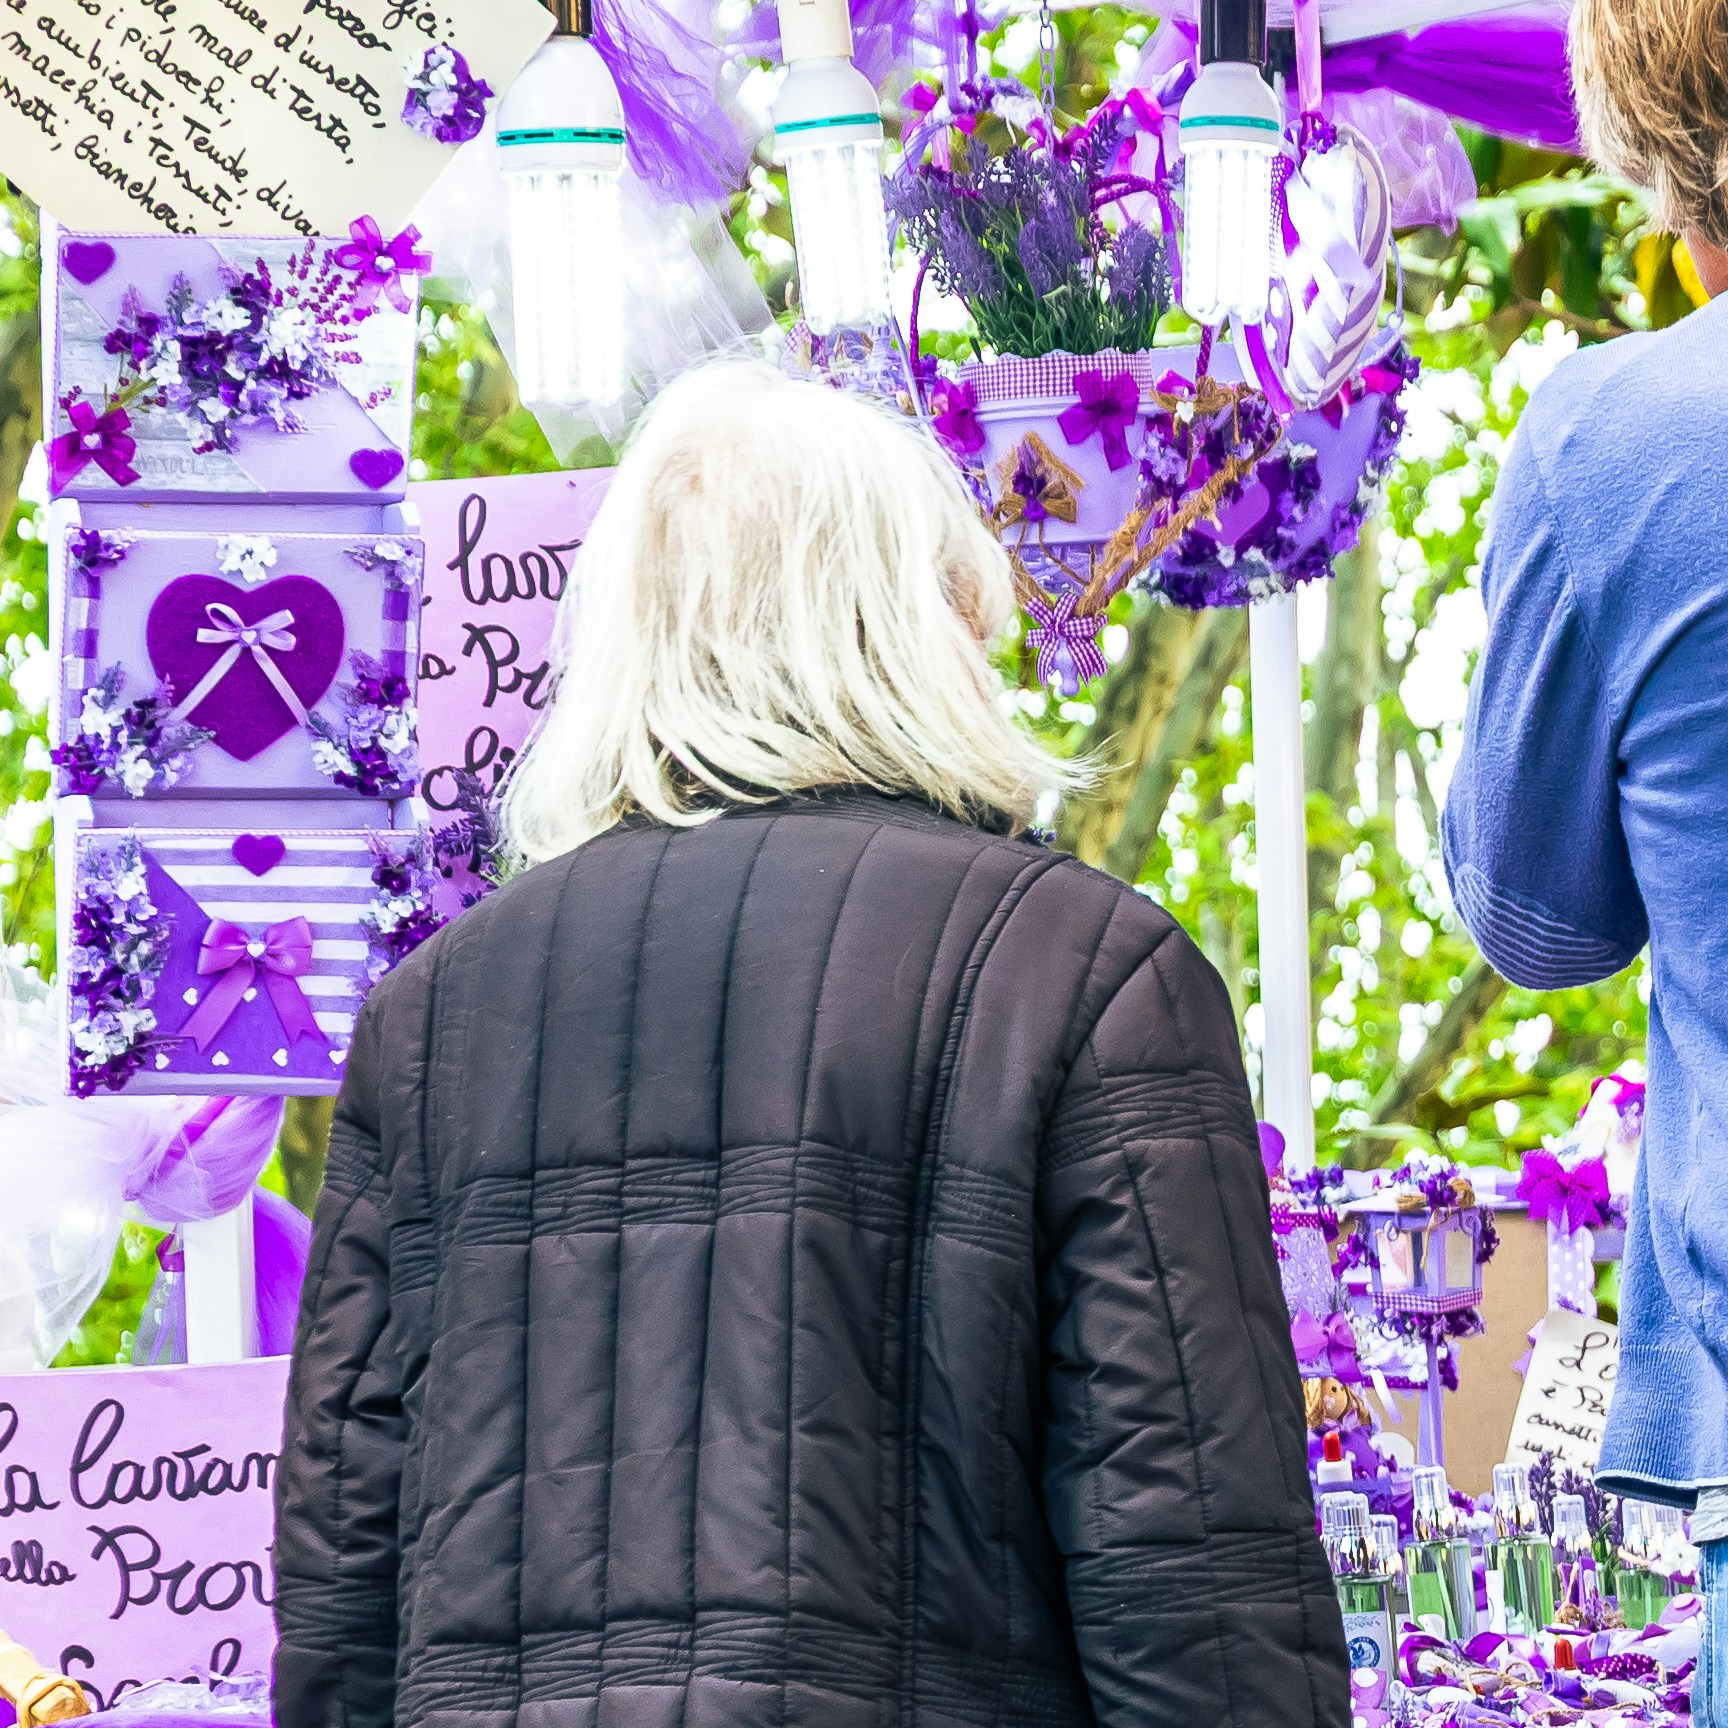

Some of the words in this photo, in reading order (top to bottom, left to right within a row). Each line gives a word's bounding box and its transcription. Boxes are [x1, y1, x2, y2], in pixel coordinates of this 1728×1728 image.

[0, 31, 114, 130] macchia
[119, 27, 236, 127] pidocchi,
[188, 24, 253, 74] mal
[251, 65, 288, 100] di
